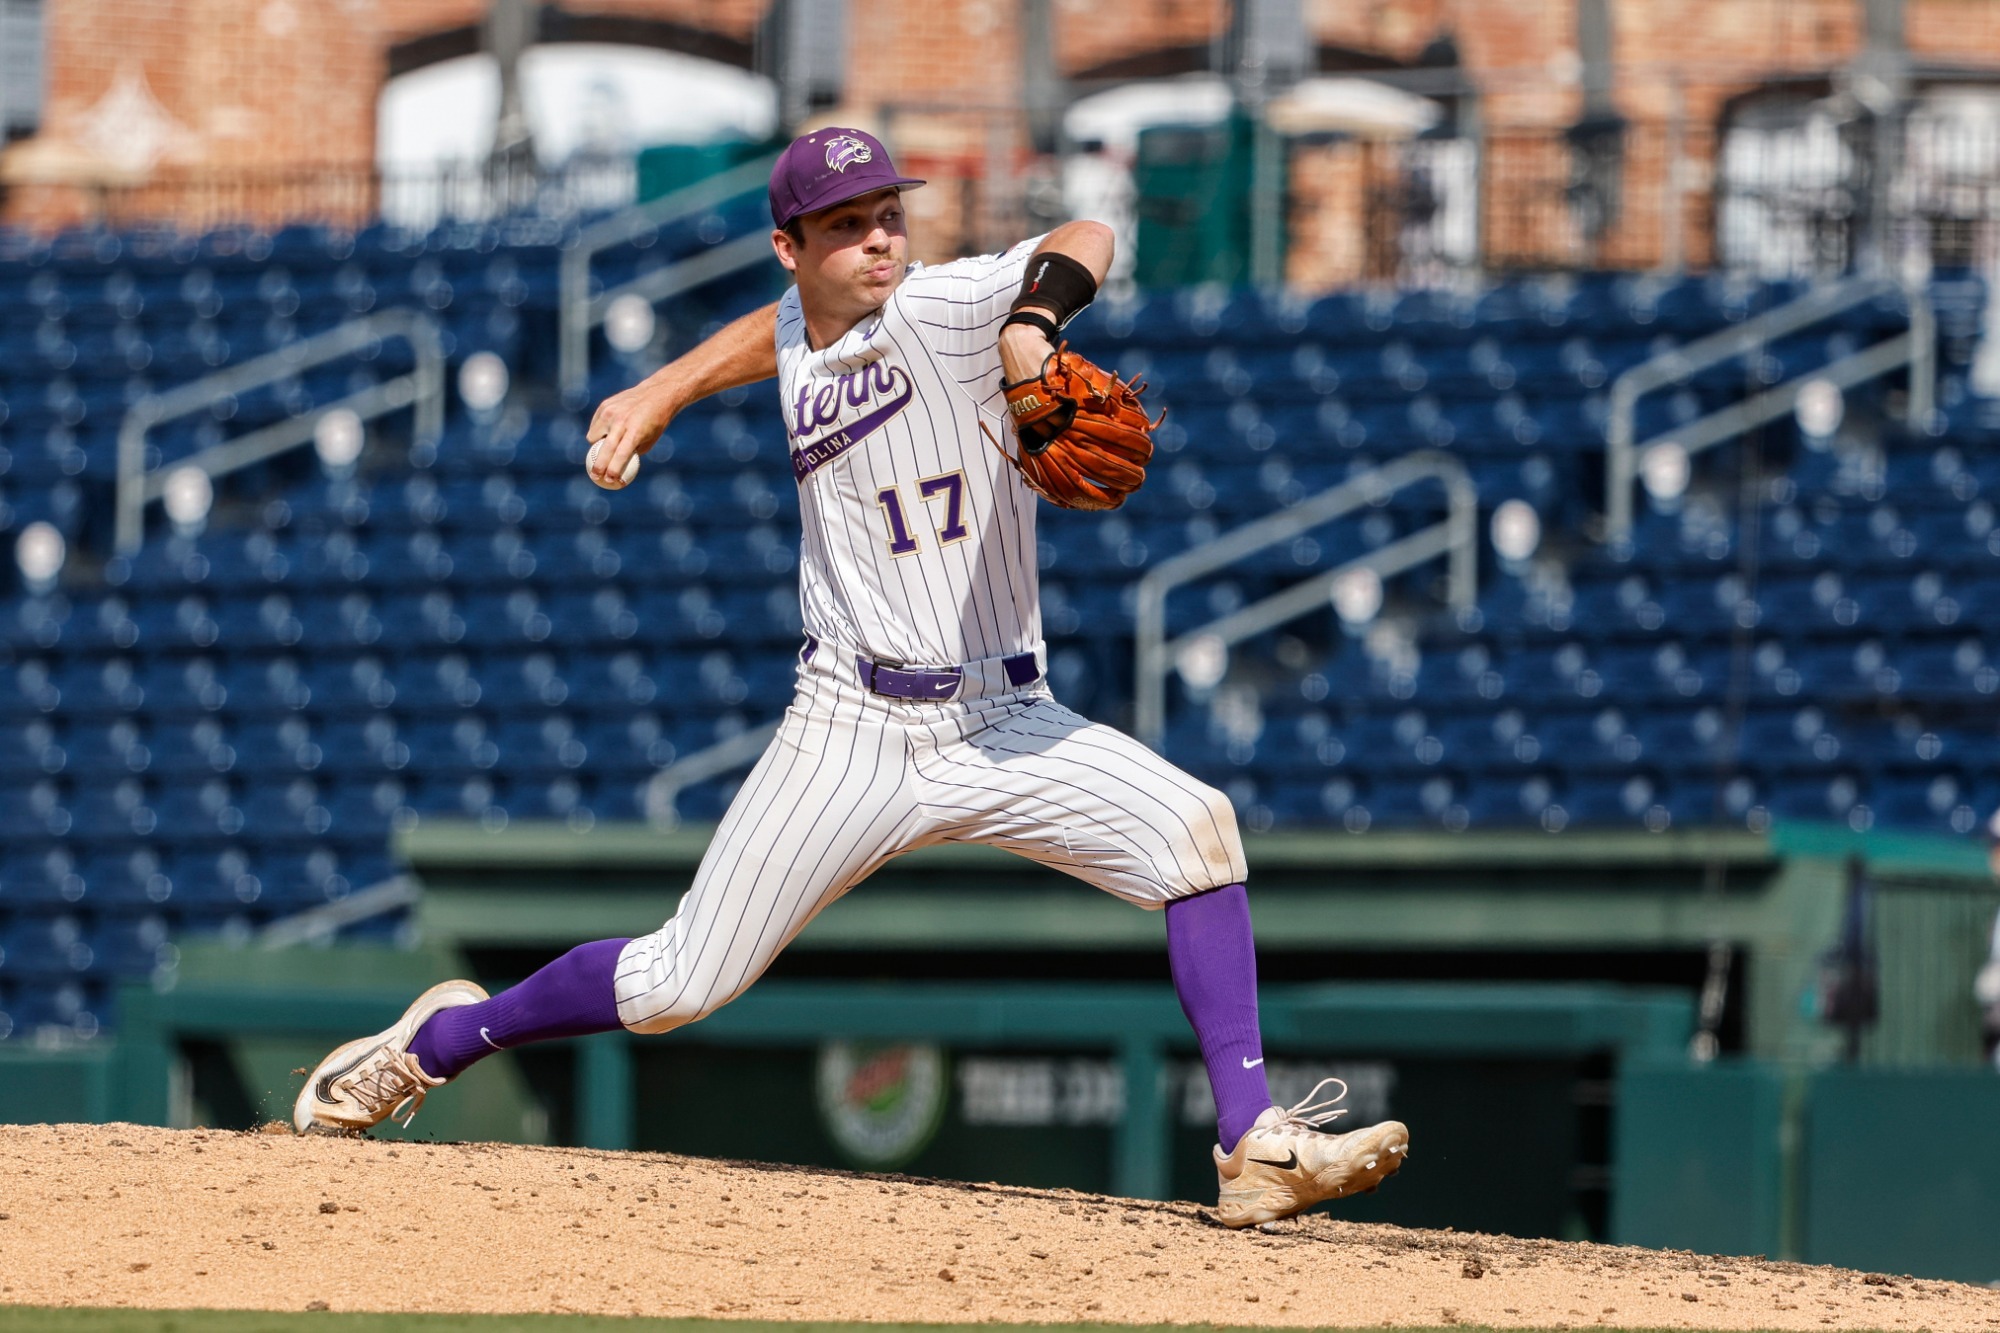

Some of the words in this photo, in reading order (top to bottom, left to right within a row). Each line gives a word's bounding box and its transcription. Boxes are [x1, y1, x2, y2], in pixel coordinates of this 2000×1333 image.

[791, 359, 913, 438] tern
[795, 430, 853, 472] CAOLINA
[873, 467, 972, 561] 17
